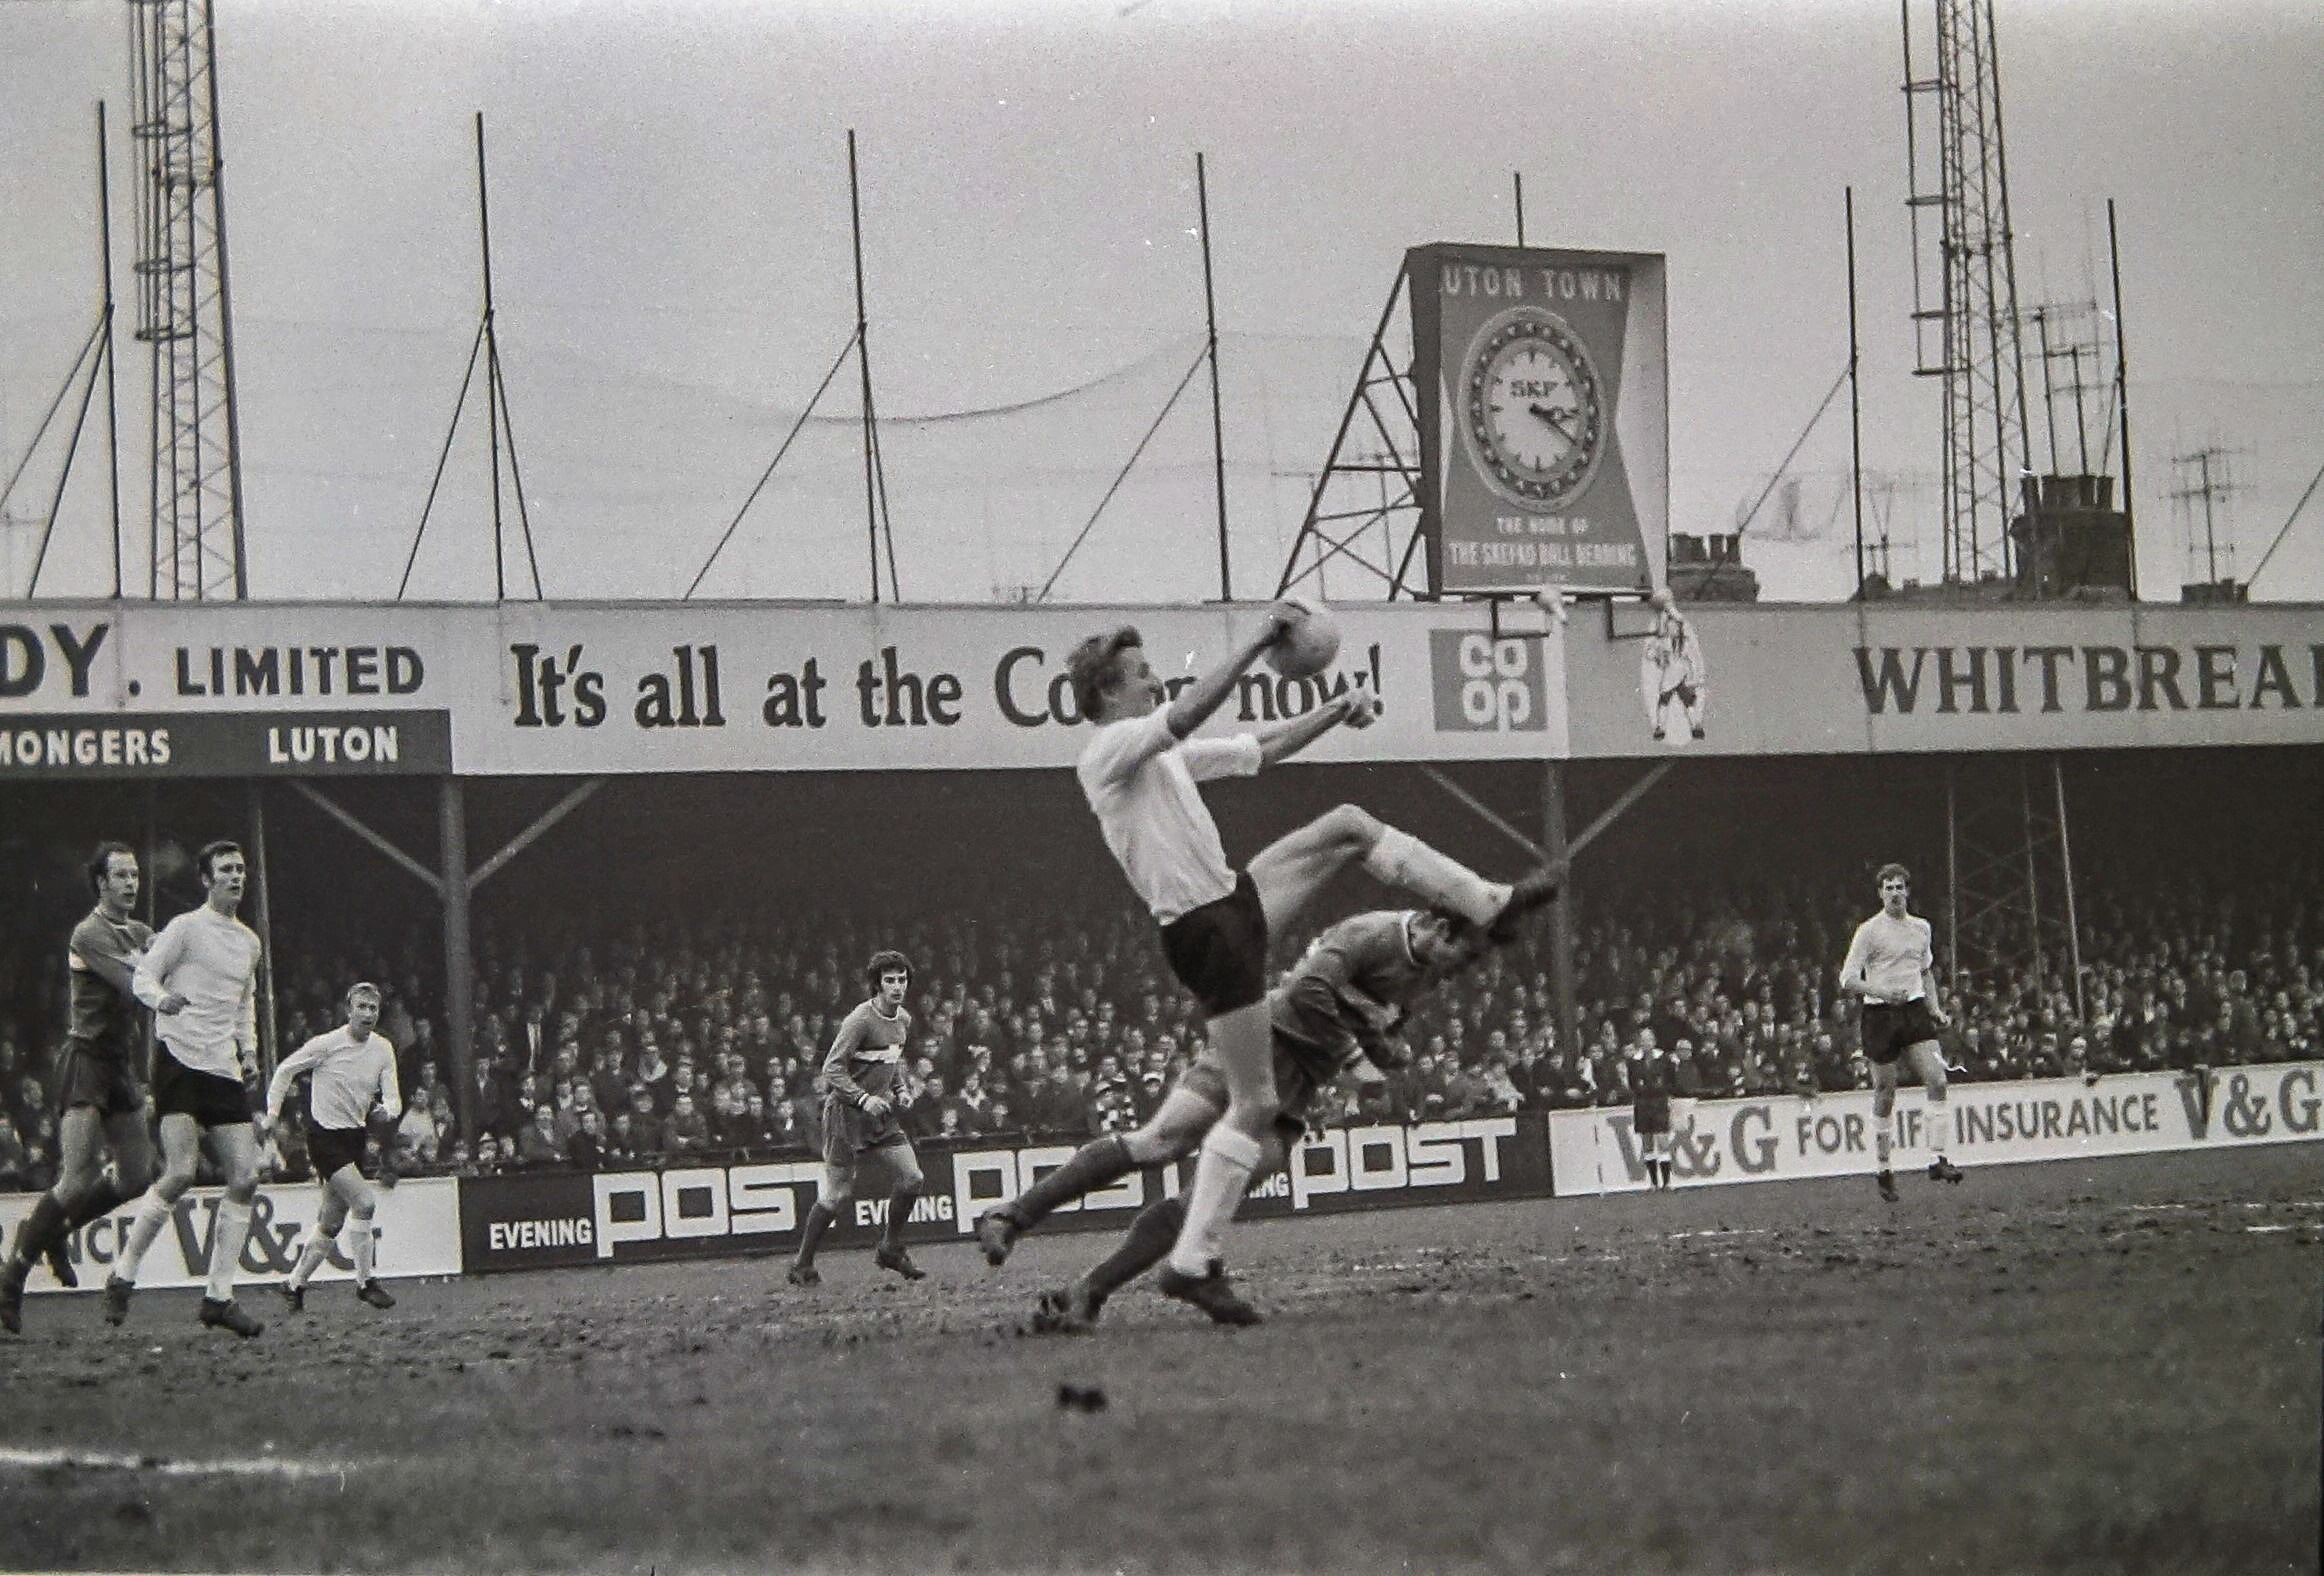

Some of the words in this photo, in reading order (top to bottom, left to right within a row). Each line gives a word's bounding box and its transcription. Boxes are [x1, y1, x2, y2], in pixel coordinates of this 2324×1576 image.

[1541, 268, 1621, 300] TOWN
[177, 647, 424, 695] LIMITED
[510, 643, 607, 727] It's
[634, 644, 727, 728] all
[762, 656, 827, 728] at
[855, 645, 962, 728] the
[269, 726, 398, 764] LUTON
[1796, 1111, 1867, 1156] FOR
[1954, 1093, 2161, 1144] INSURANCE
[2172, 1067, 2323, 1141] V&G
[489, 1217, 593, 1251] EVENING
[1290, 1116, 1518, 1210] POST
